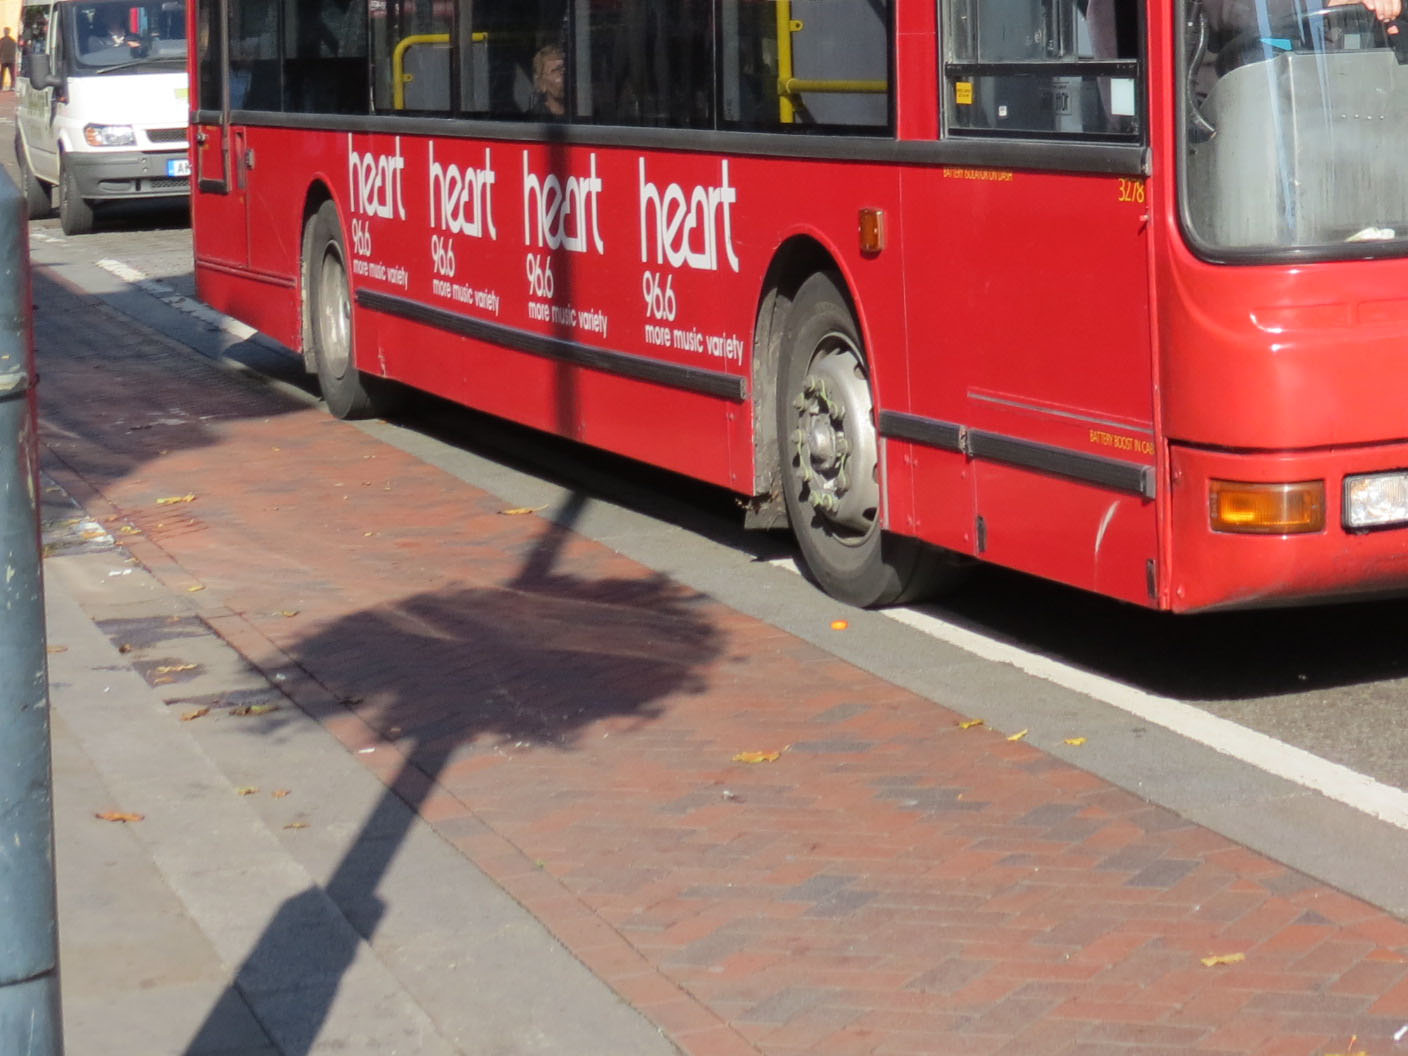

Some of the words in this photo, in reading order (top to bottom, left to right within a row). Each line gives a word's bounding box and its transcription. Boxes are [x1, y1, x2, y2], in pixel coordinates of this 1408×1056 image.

[348, 132, 406, 221] heart
[429, 140, 496, 241] heart
[1118, 177, 1145, 203] 3278
[523, 150, 604, 255] heart
[639, 157, 739, 273] heart
[353, 259, 369, 276] more
[369, 261, 386, 280] music
[387, 265, 408, 291] variety
[431, 235, 456, 277] 96.6
[526, 253, 554, 298] 96.6
[433, 279, 452, 298] more
[453, 283, 473, 304] music
[474, 288, 500, 316] variety
[643, 271, 676, 321] 96.6
[528, 301, 550, 321] more
[552, 303, 577, 326] music
[578, 308, 608, 338] variety
[645, 325, 671, 346] more
[673, 328, 703, 353] music
[706, 333, 744, 366] variety
[1089, 429, 1113, 446] BATTERY
[1114, 435, 1134, 451] BOOST
[1134, 439, 1141, 453] IN
[1142, 441, 1155, 455] CAB
